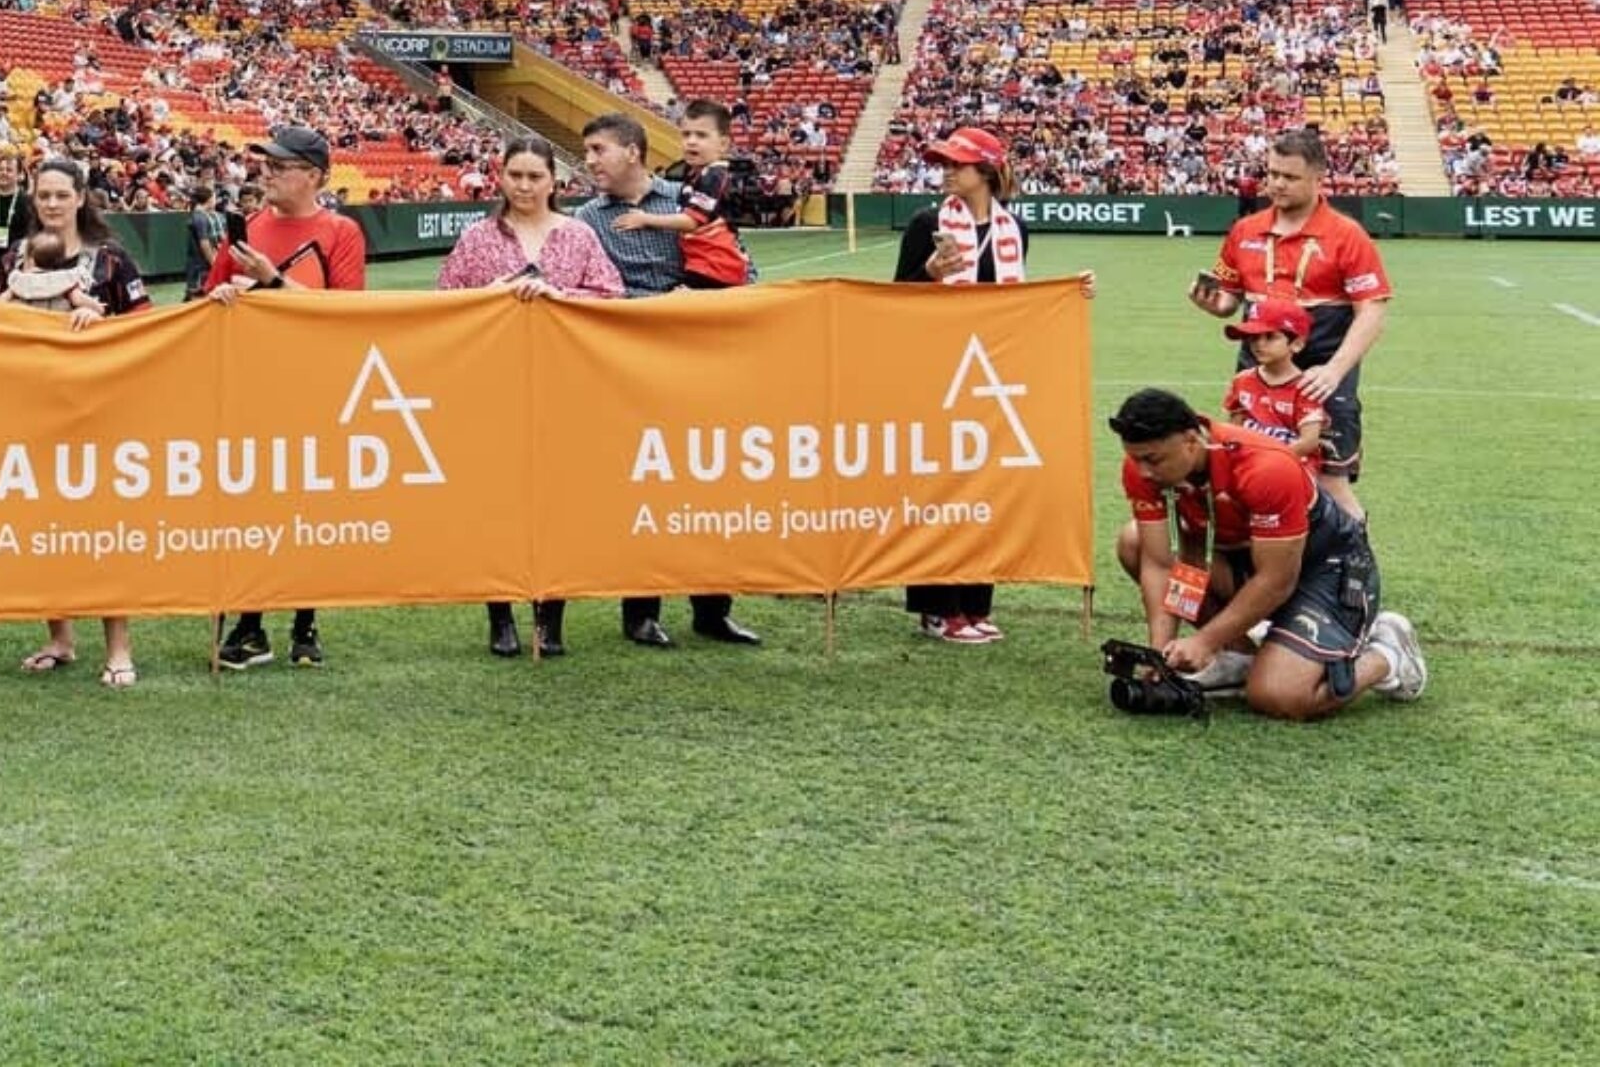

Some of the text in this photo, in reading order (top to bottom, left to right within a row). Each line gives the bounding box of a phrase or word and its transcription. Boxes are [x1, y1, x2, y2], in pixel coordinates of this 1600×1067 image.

[453, 38, 511, 54] STADIUM
[417, 212, 440, 238] LEST
[1043, 202, 1146, 222] FORGET
[1465, 205, 1596, 227] LEST WE
[631, 420, 989, 482] AUSBUILD
[632, 496, 993, 540] A simple journey home
[31, 522, 148, 559] simple
[152, 522, 284, 560] journey
[294, 515, 392, 545] home
